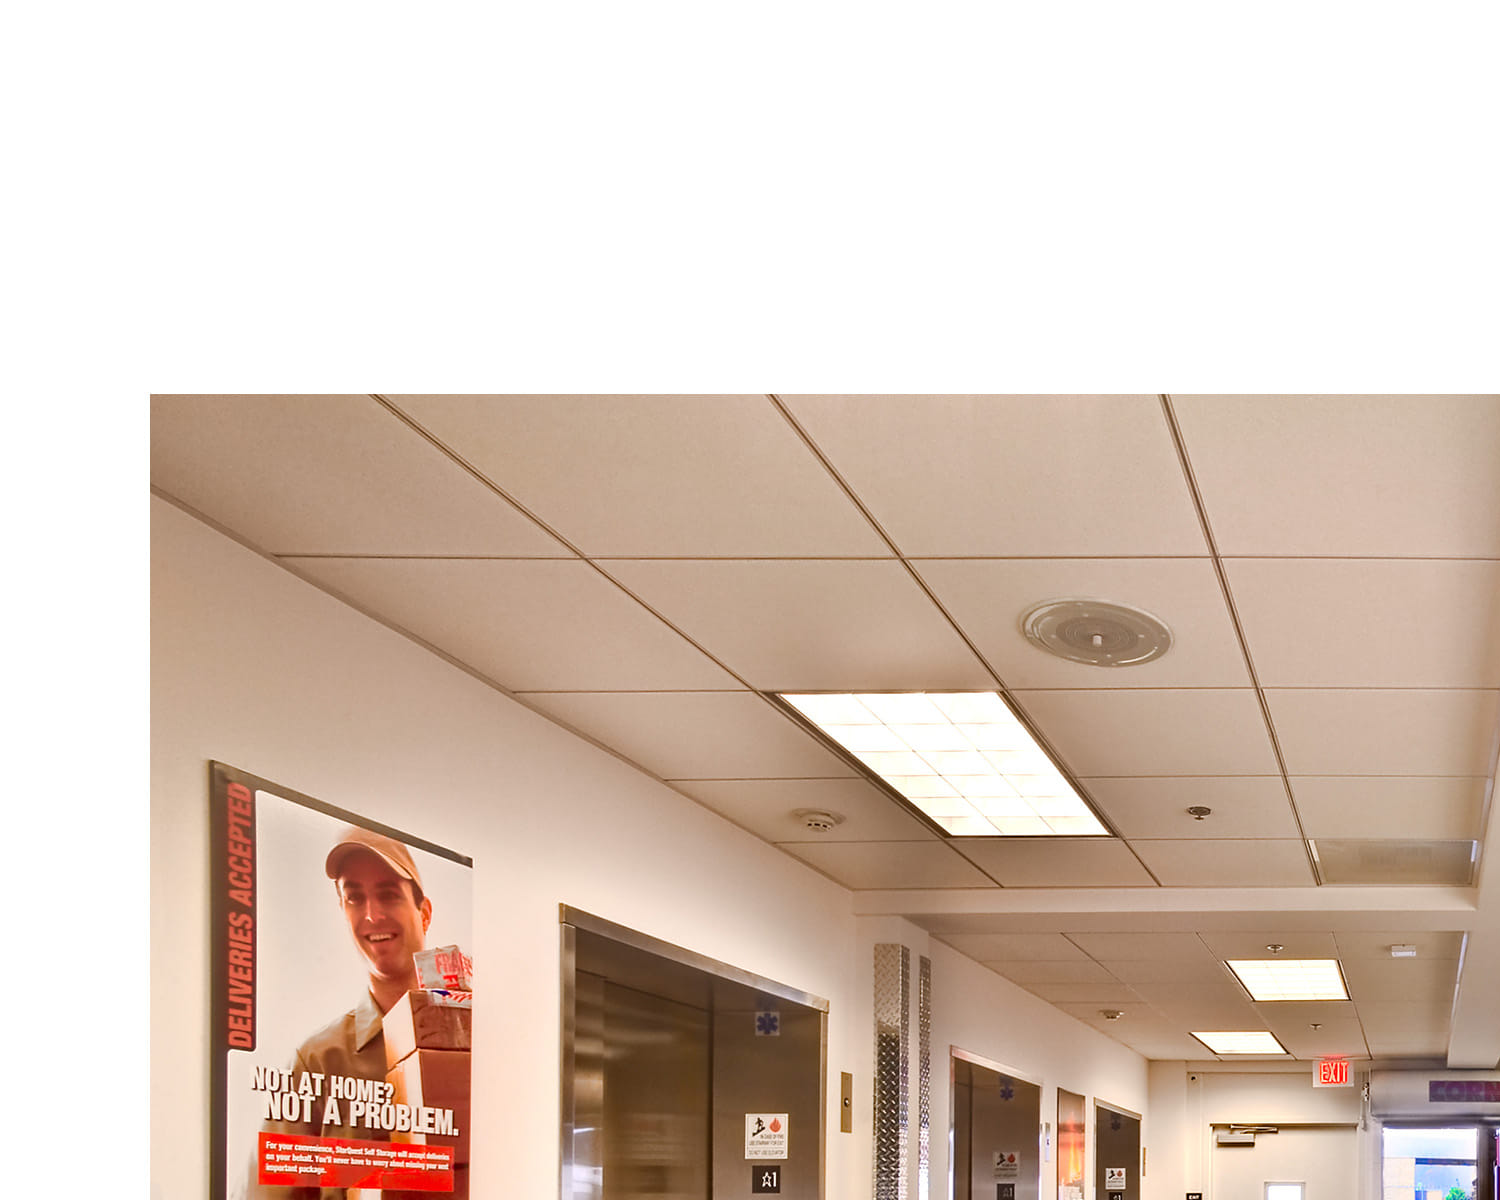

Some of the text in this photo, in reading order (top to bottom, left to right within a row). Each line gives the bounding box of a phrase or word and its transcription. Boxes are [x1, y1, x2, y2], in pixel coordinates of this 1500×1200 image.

[227, 781, 253, 1049] DELIVERIES ACCEPTED
[1320, 1061, 1349, 1084] EXIT
[251, 1064, 395, 1105] NOT AT HOME?
[264, 1090, 460, 1137] NOT A PROBLEM.
[265, 1141, 278, 1150] For
[278, 1143, 293, 1152] your
[276, 1154, 291, 1162] your
[265, 1163, 298, 1173] important
